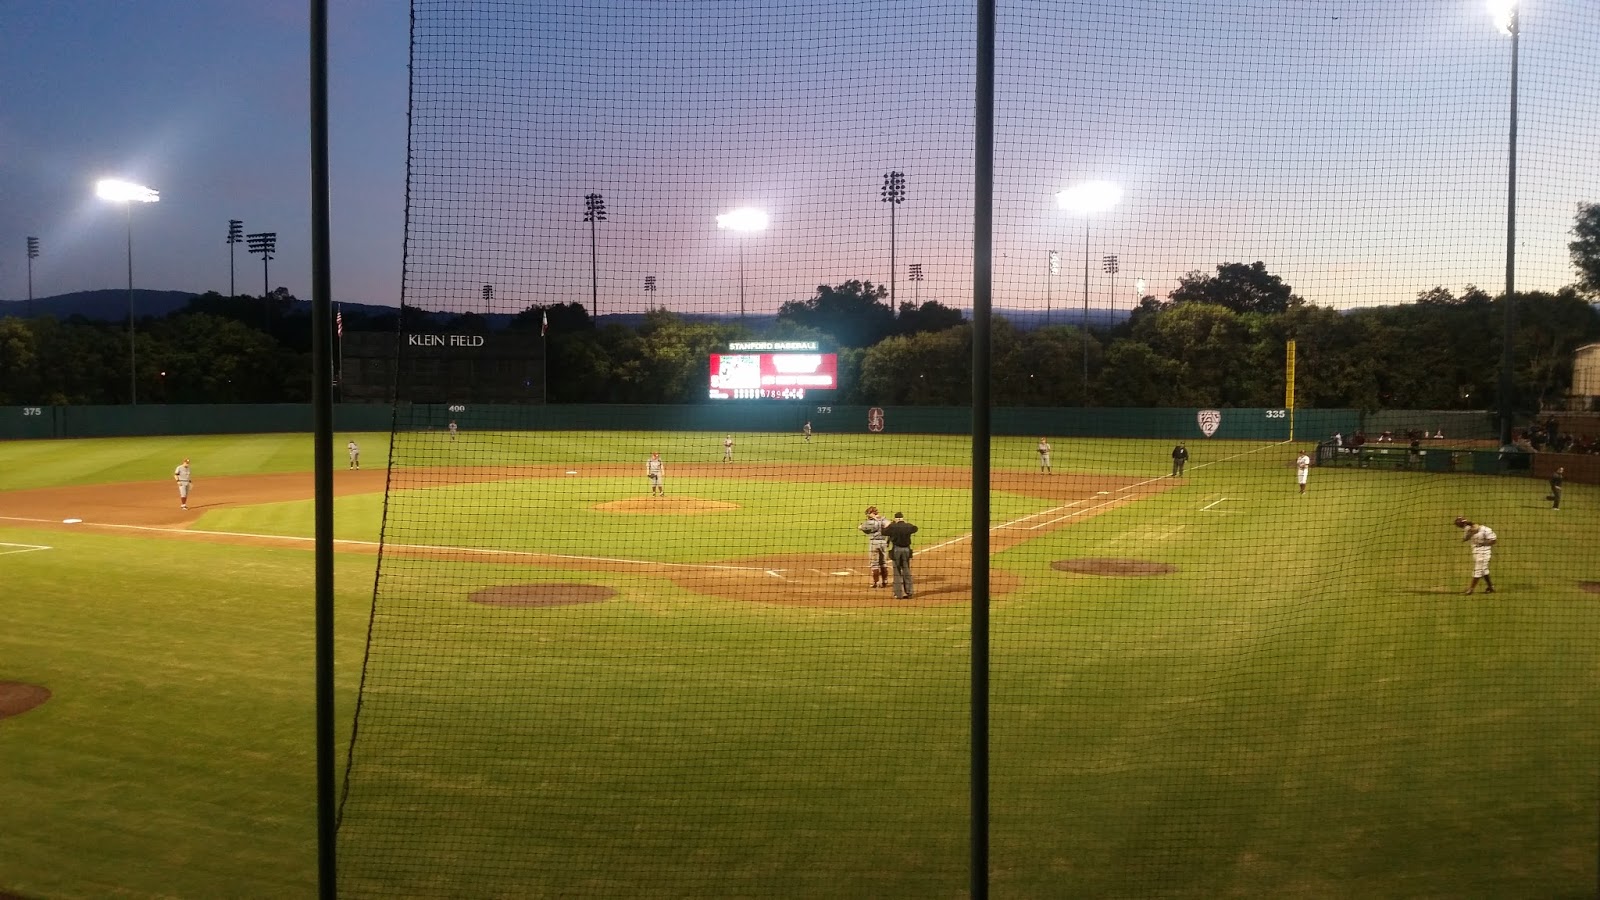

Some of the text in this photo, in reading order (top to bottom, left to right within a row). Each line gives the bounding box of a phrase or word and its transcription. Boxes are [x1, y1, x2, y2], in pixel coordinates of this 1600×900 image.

[408, 334, 484, 347] KLEIN FIELD
[729, 342, 817, 350] STANFORD BASEBALL
[23, 407, 41, 416] 375
[817, 406, 832, 414] 375
[1204, 423, 1214, 431] 12
